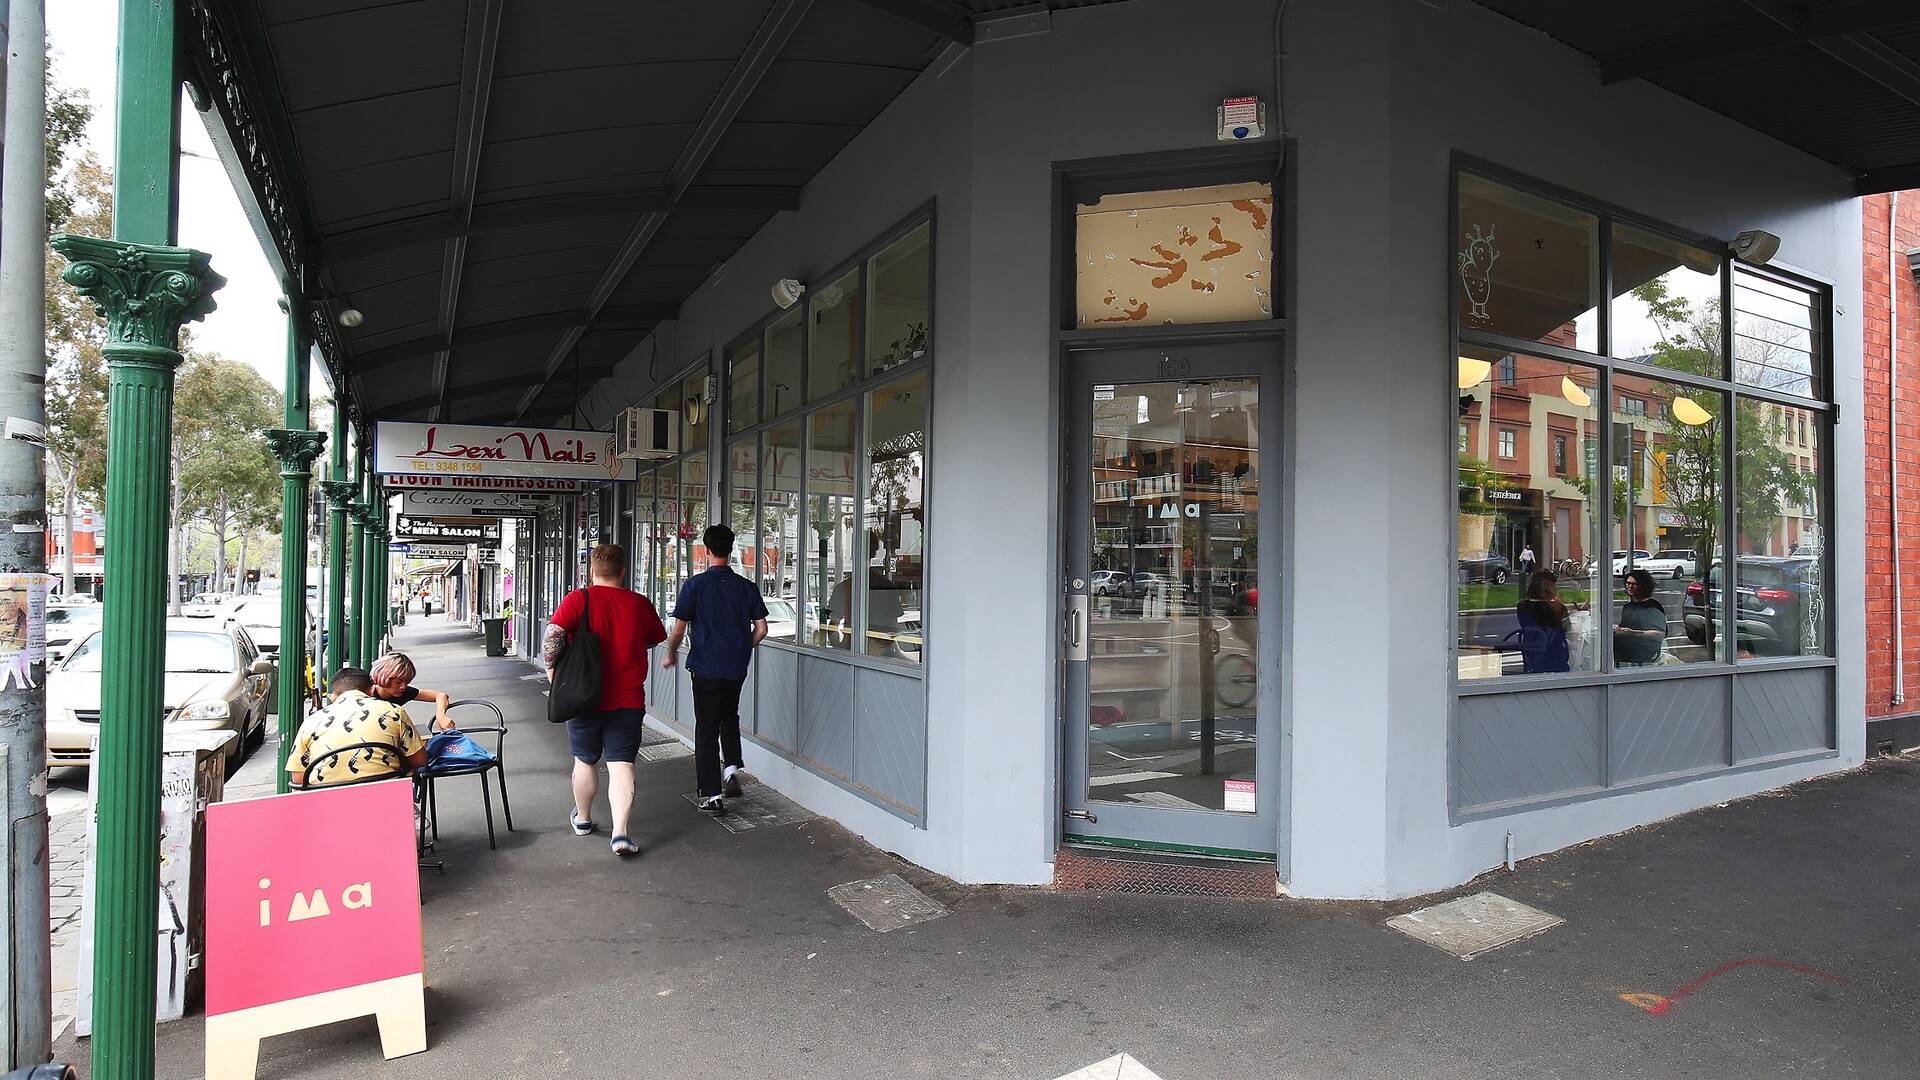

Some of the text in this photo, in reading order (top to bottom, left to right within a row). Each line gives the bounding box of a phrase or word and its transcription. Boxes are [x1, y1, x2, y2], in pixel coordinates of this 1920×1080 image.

[1159, 357, 1190, 378] 169
[416, 426, 596, 463] Lexi Nails
[412, 461, 434, 470] TEL:
[436, 462, 459, 472] 9348
[408, 490, 483, 506] Carlton
[412, 526, 439, 535] MEN
[441, 528, 481, 537] SALON
[1226, 783, 1254, 791] WARNING
